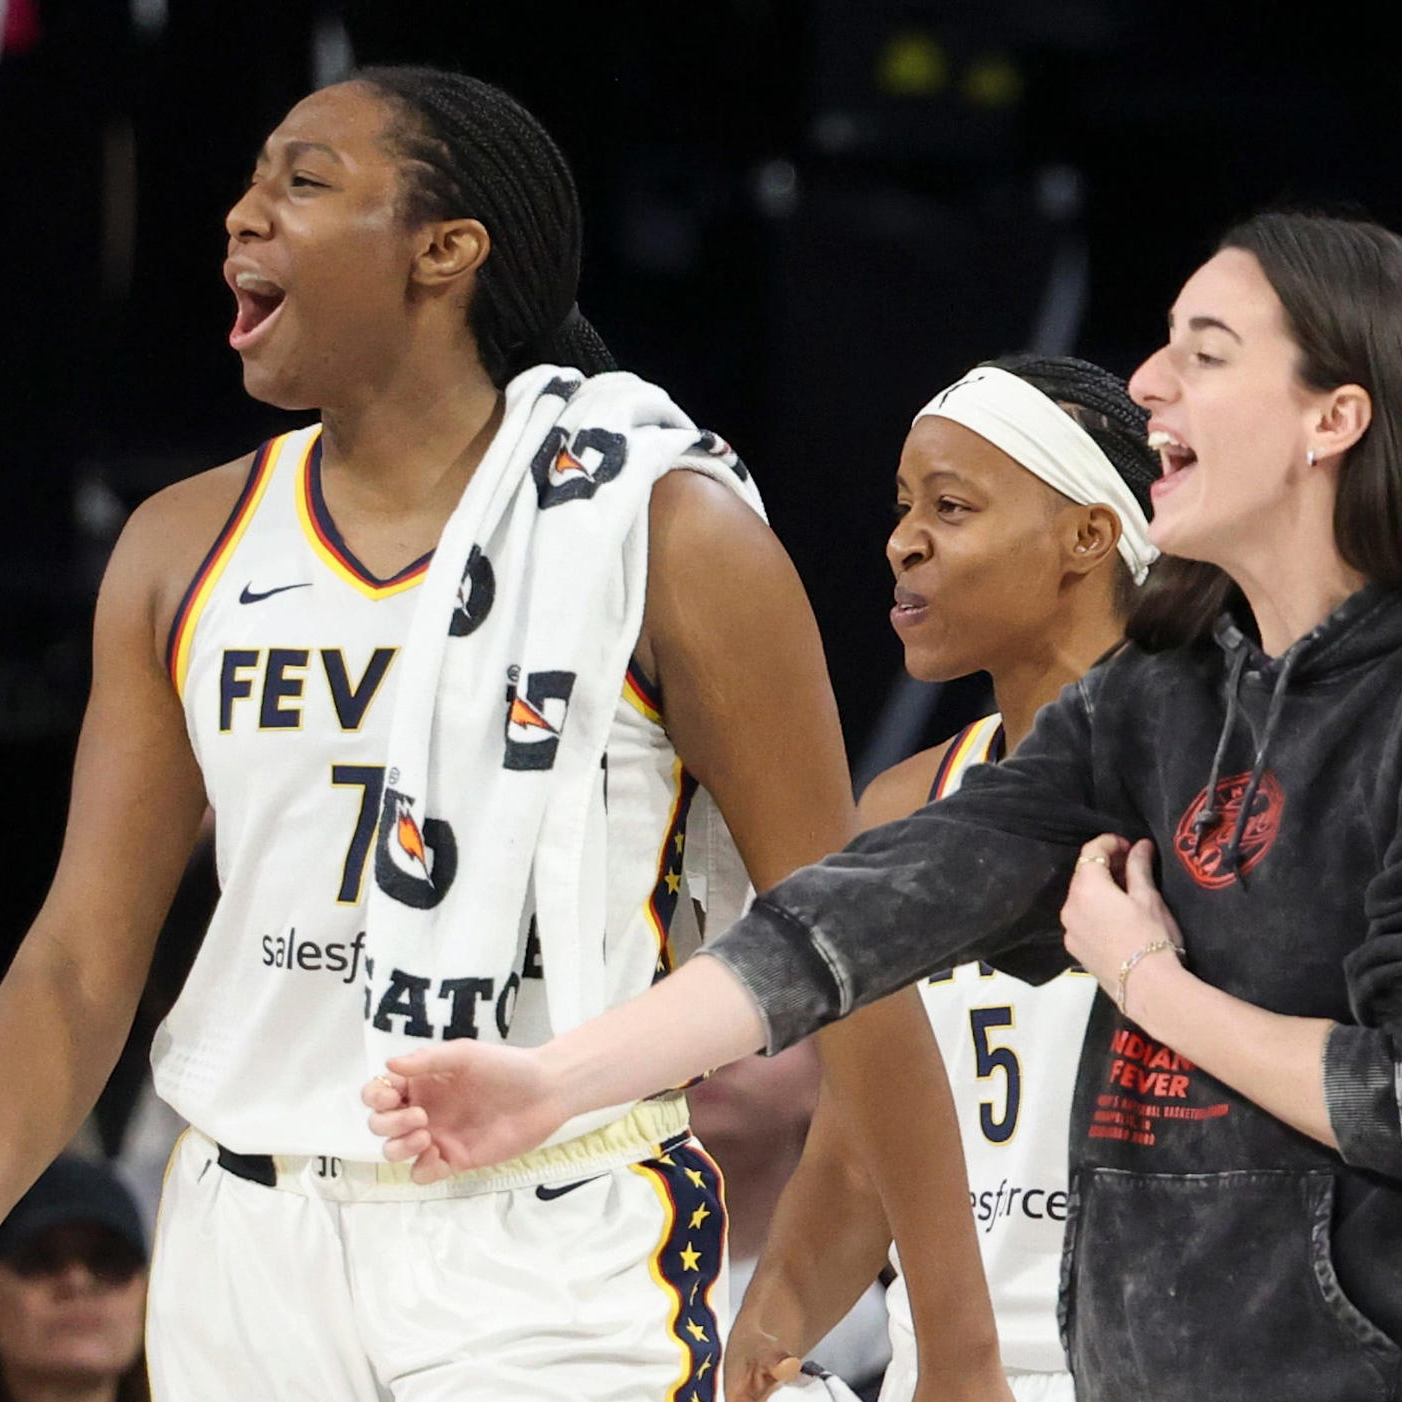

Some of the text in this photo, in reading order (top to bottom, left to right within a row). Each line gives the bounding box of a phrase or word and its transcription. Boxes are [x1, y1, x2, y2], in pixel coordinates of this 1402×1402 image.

[218, 645, 401, 736] FEV
[330, 762, 388, 908] 7
[261, 926, 367, 984] salesf
[968, 1002, 1023, 1147] 5
[1108, 1058, 1190, 1100] FEVER
